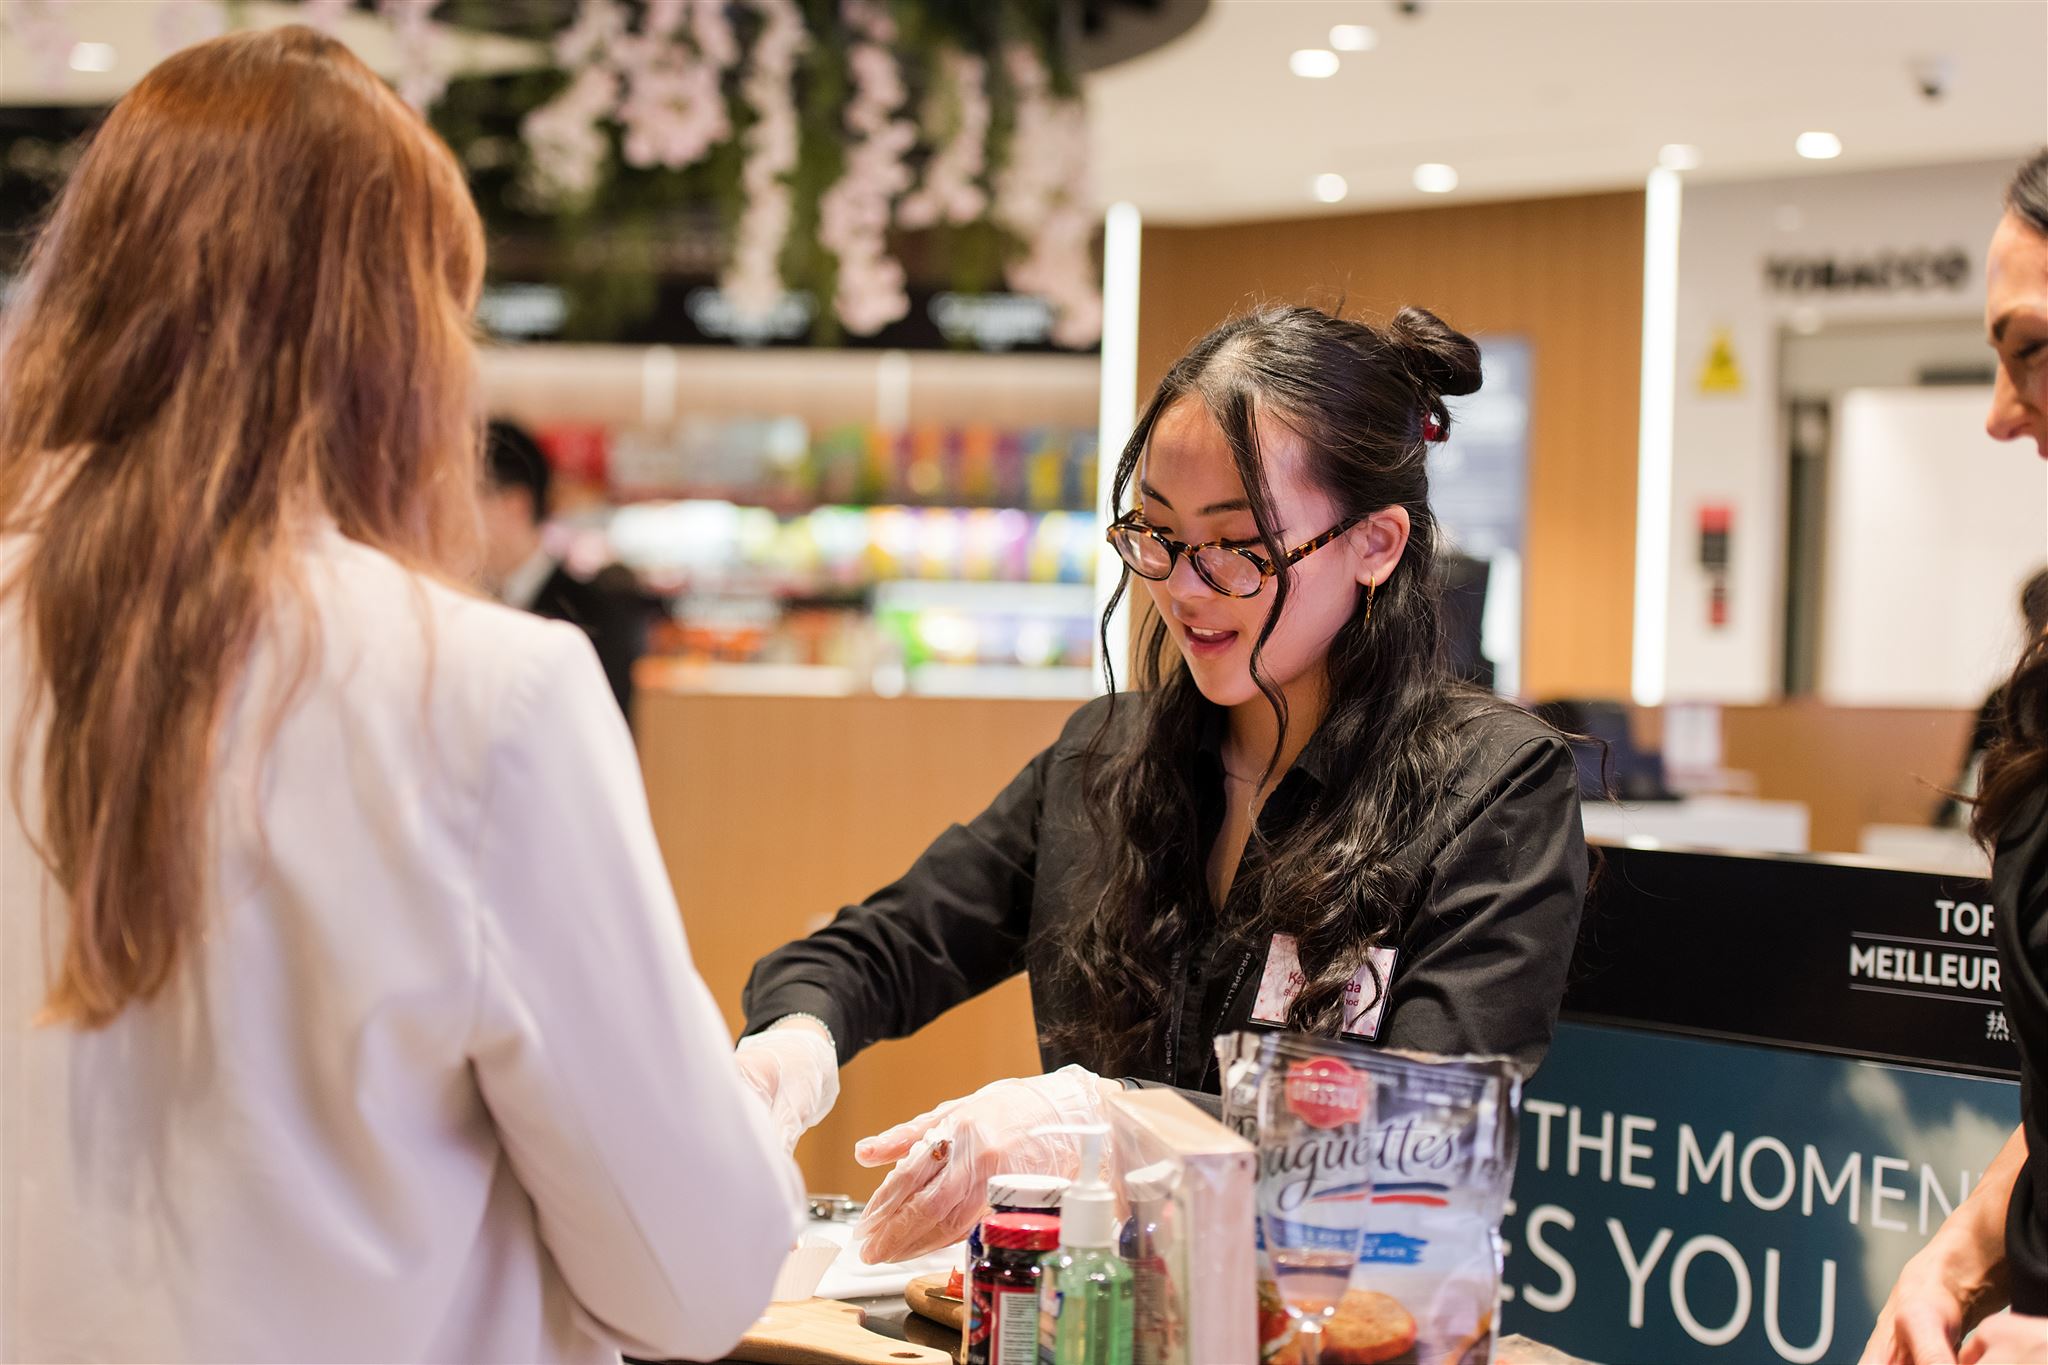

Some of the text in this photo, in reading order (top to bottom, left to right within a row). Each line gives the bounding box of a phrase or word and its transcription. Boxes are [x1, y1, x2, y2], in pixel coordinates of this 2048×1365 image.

[1849, 943, 2002, 993] MEILLEUR
[1985, 1010, 2016, 1043] 热
[1523, 1098, 1983, 1237] THE MOMEN
[1605, 1217, 1837, 1365] YOU
